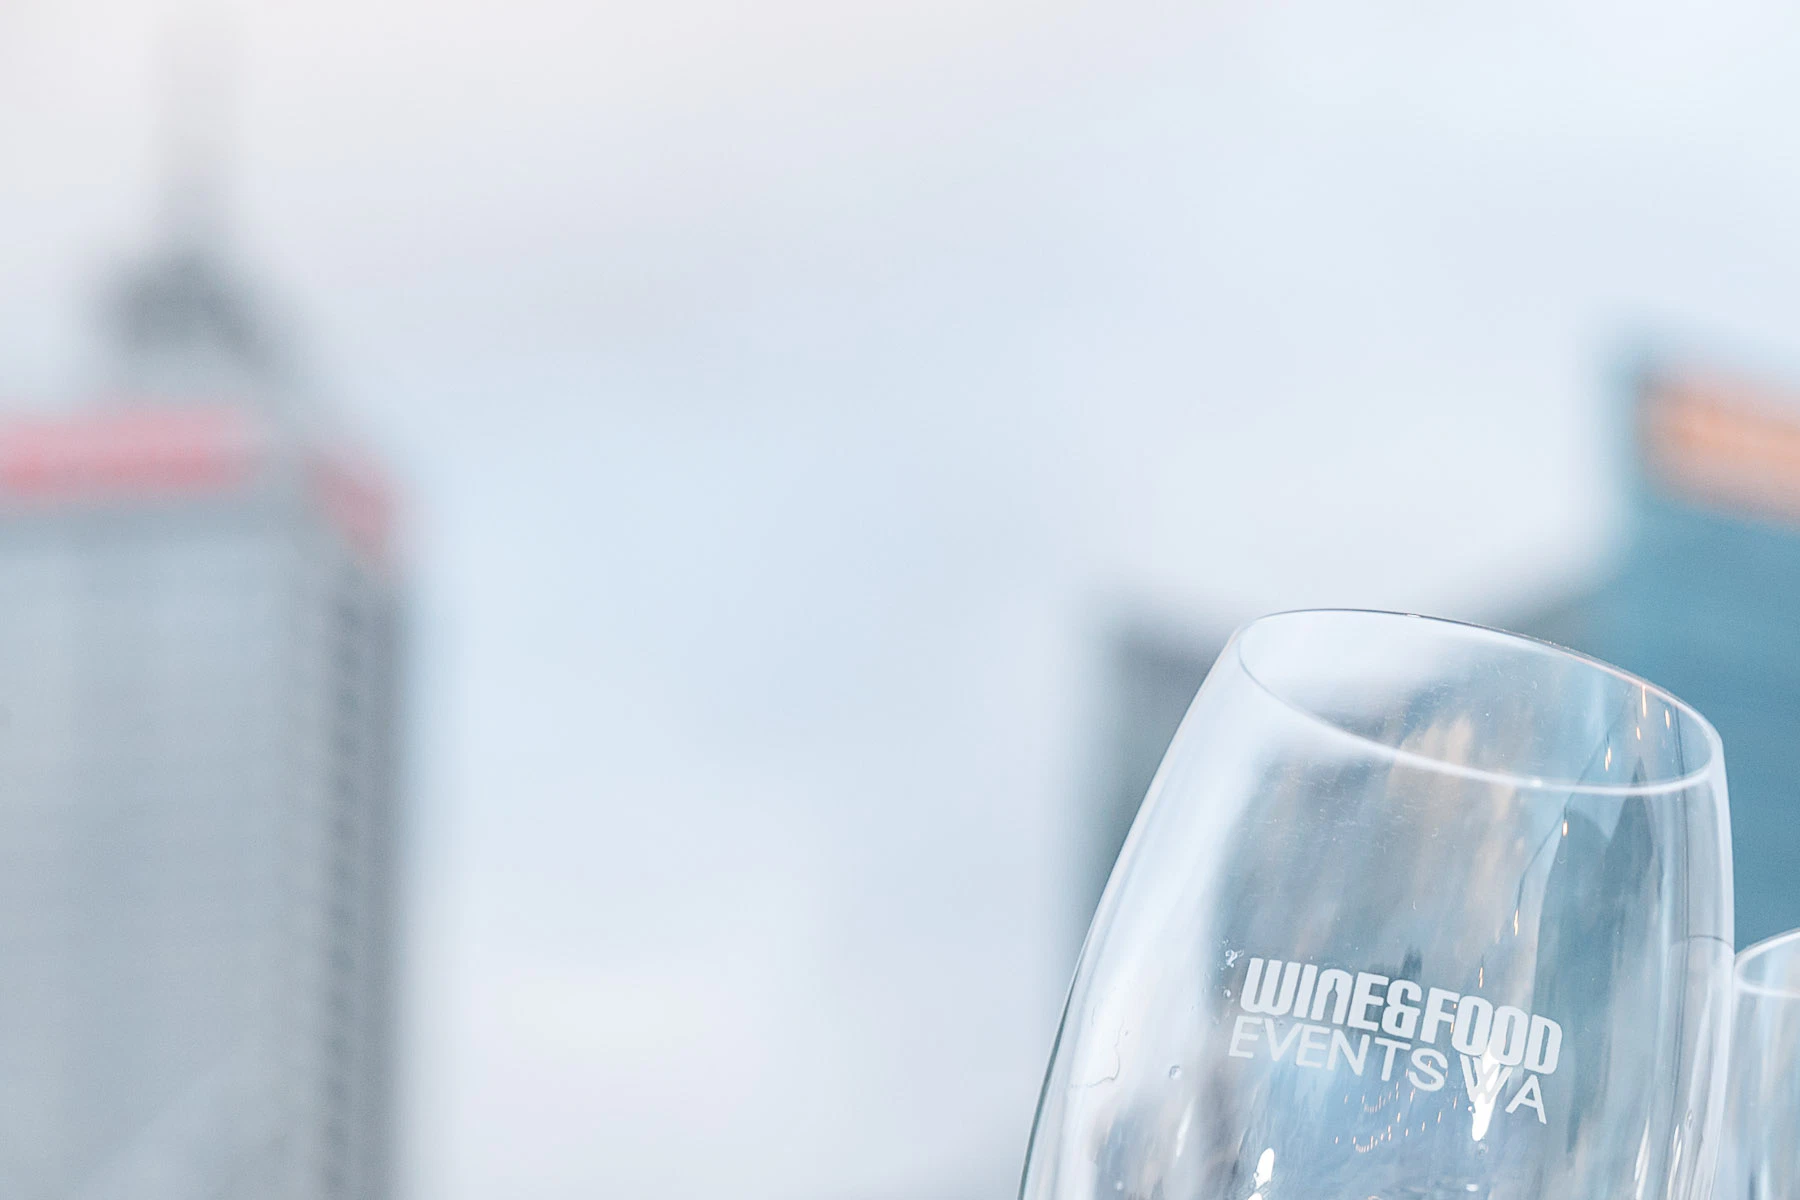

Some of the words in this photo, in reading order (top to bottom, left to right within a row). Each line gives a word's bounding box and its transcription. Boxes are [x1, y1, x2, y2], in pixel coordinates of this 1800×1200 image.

[1228, 1015, 1448, 1092] EVENTS
[1459, 1053, 1547, 1125] WA
[1240, 957, 1563, 1075] WINE&FOOD
